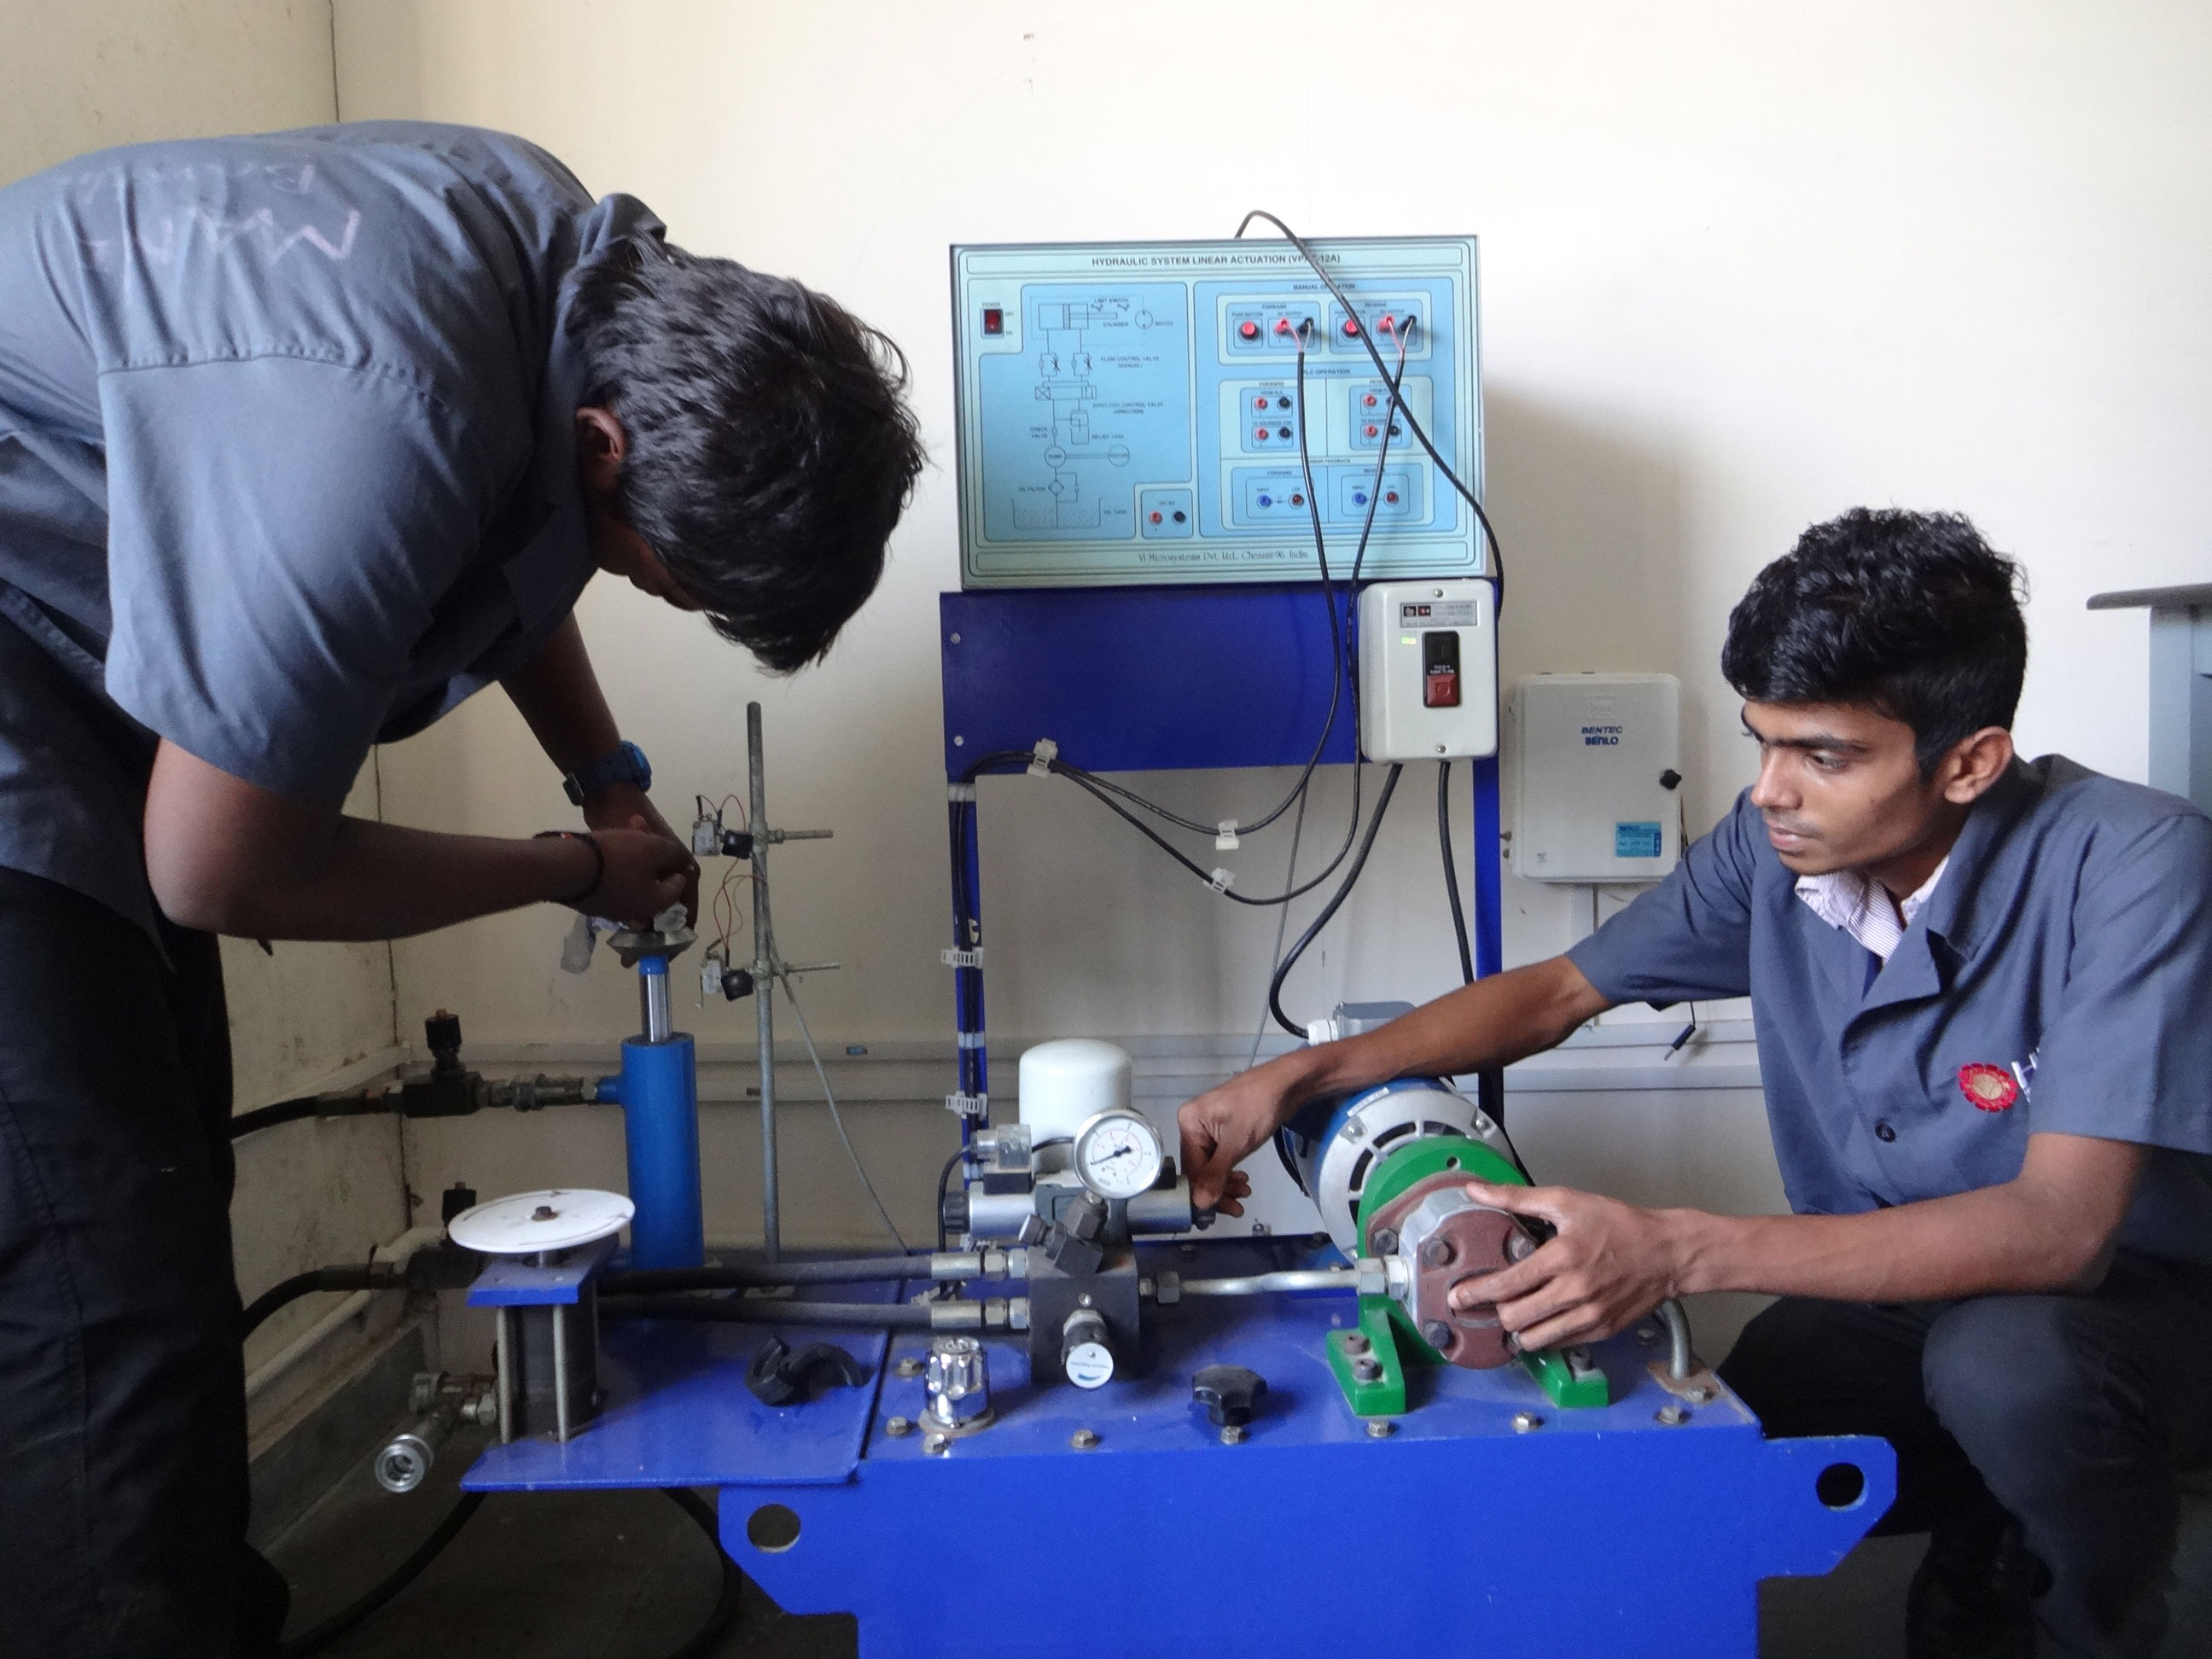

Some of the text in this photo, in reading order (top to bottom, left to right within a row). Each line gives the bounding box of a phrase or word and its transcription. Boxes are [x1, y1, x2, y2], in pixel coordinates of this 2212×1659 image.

[1091, 257, 1148, 267] HYDRAULIC
[1150, 257, 1190, 265] SYSTEM
[1192, 256, 1227, 265] LINEAR
[1231, 255, 1286, 265] ACTUATION
